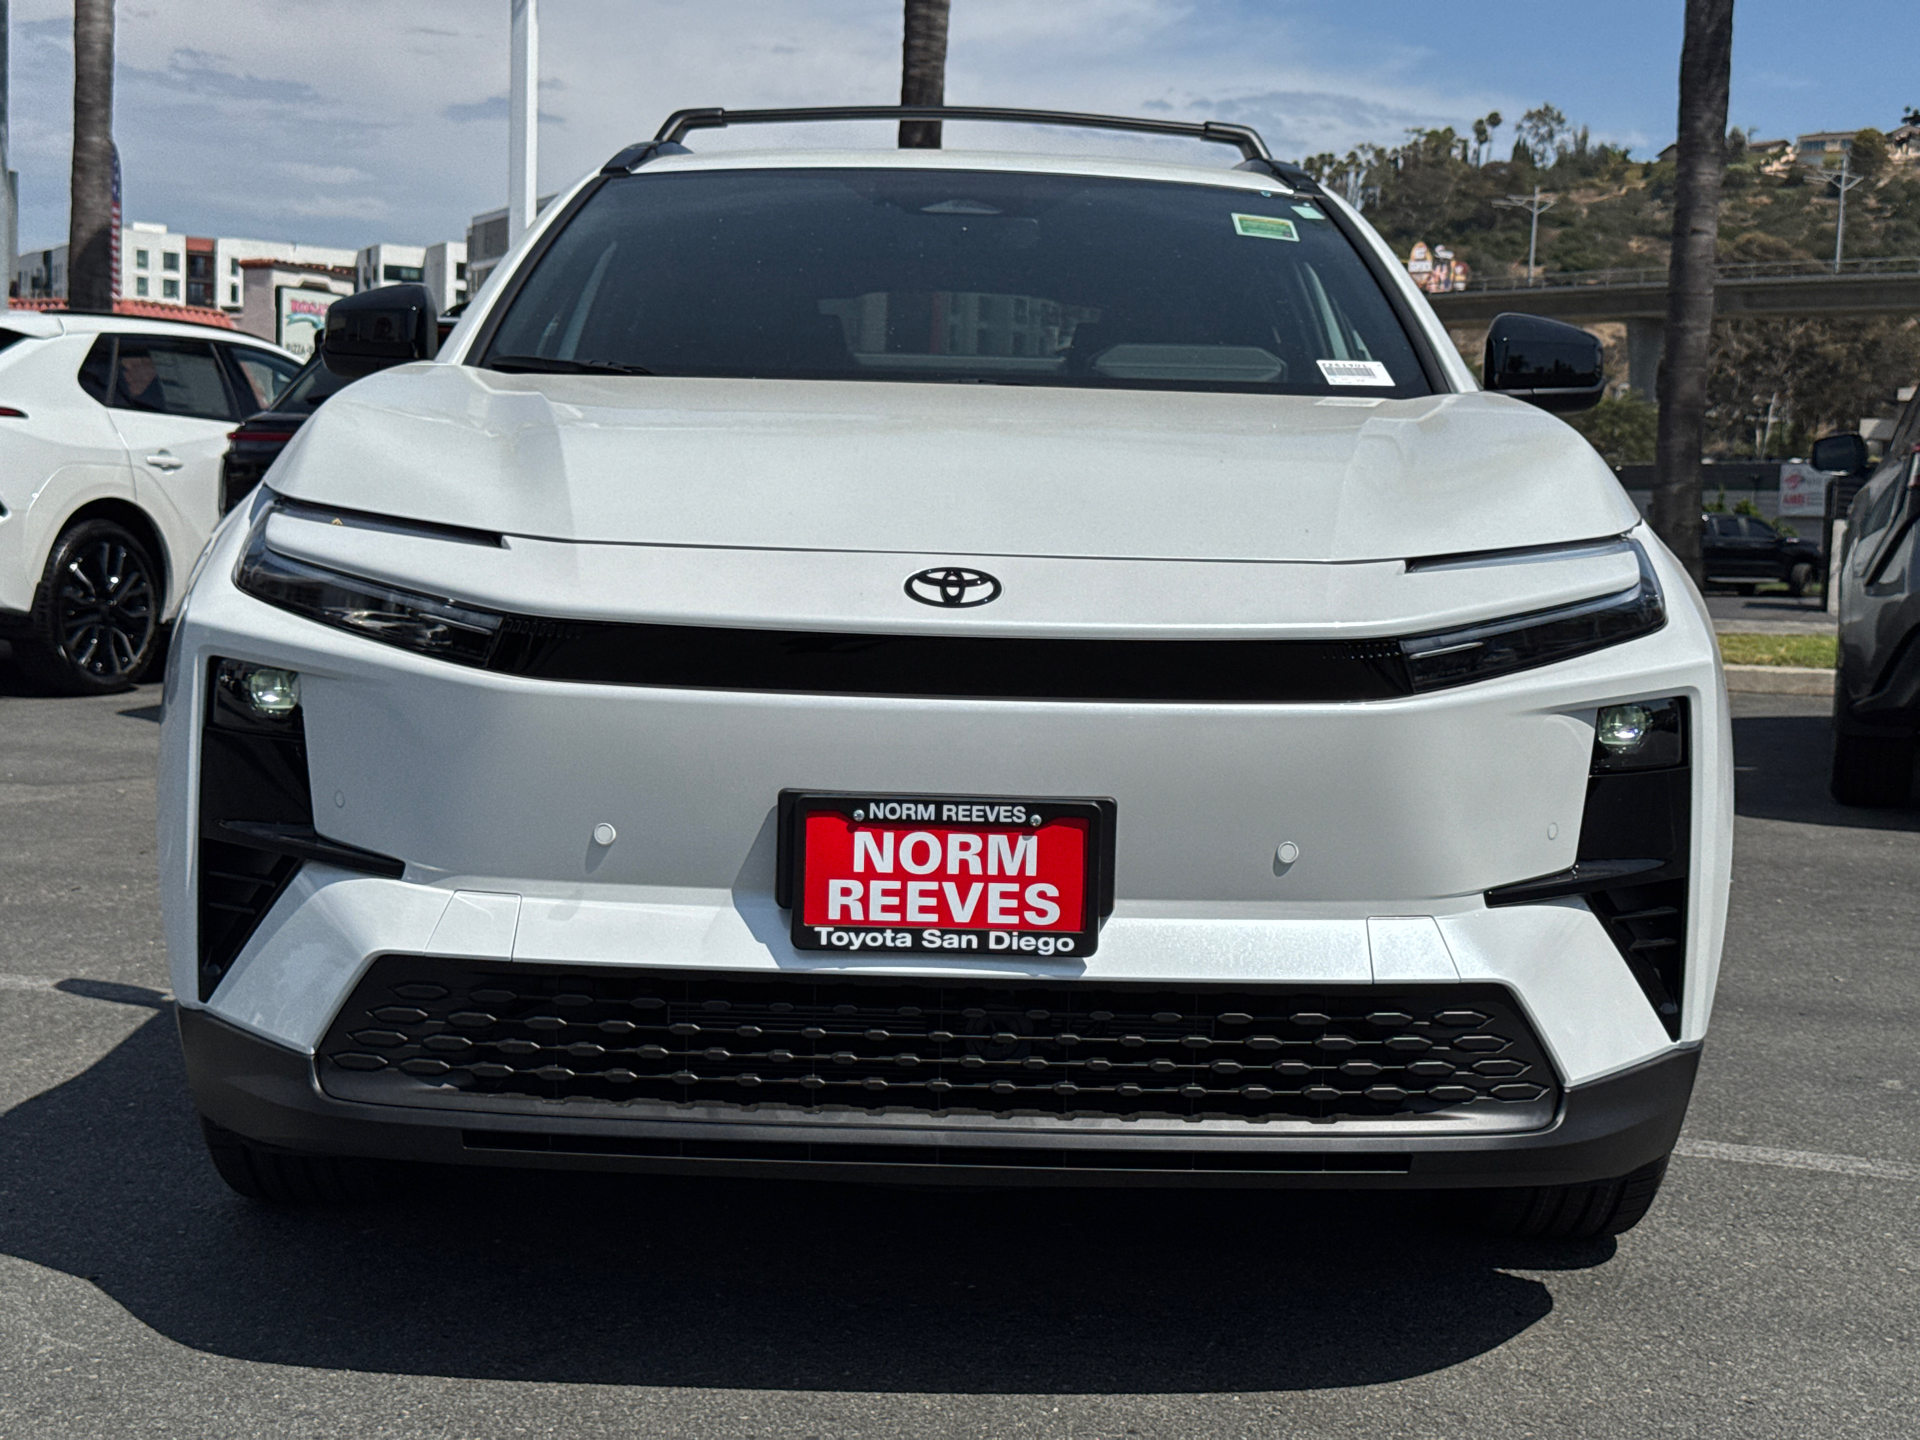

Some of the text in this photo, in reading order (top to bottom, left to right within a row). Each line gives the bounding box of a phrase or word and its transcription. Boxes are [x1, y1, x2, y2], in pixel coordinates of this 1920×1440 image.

[869, 802, 1027, 823] NORM REEVES
[853, 831, 1038, 877] NORM
[827, 879, 1061, 926] REEVES
[814, 926, 1075, 956] Toyota San Diego
